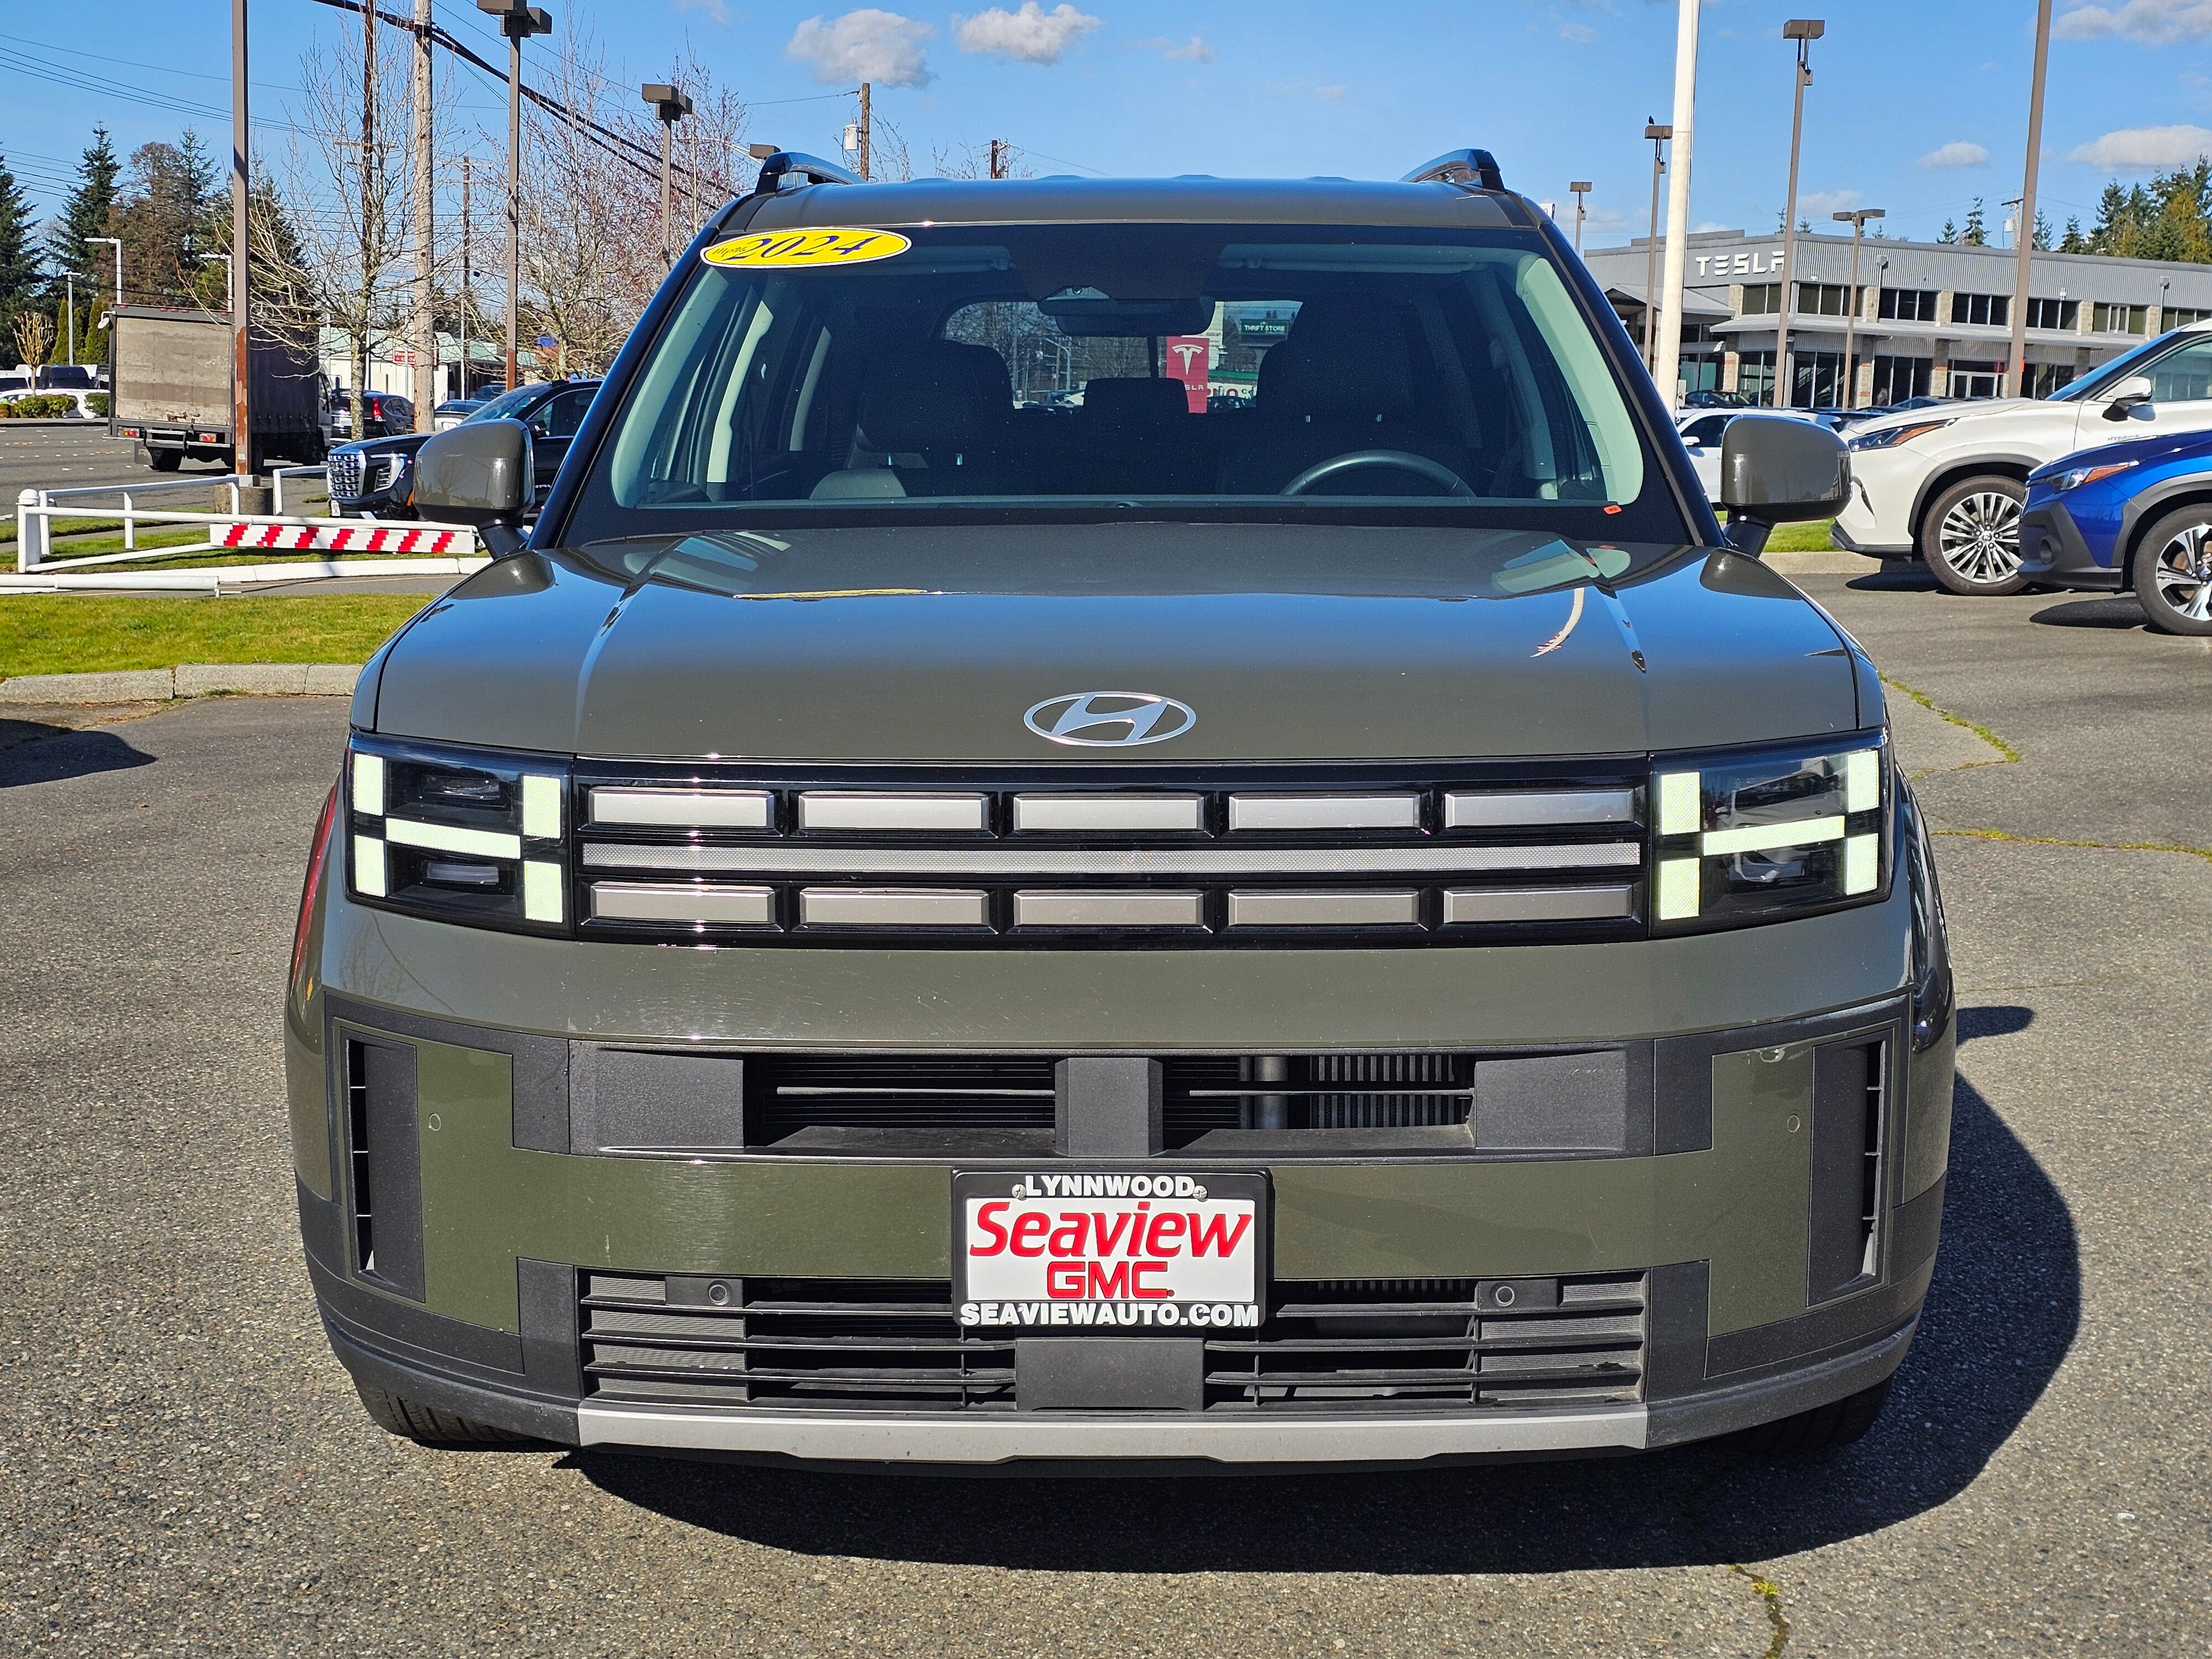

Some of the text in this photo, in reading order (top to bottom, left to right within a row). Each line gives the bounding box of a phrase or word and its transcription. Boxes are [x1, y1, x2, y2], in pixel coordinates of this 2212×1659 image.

[722, 235, 883, 261] 2024
[1695, 251, 1785, 277] TESLA
[1025, 1175, 1196, 1197] LYNNWOOD
[969, 1201, 1253, 1258] Seaview
[1047, 1261, 1168, 1299] GMC
[960, 1302, 1259, 1327] SEAVIEWAUTO.COM
